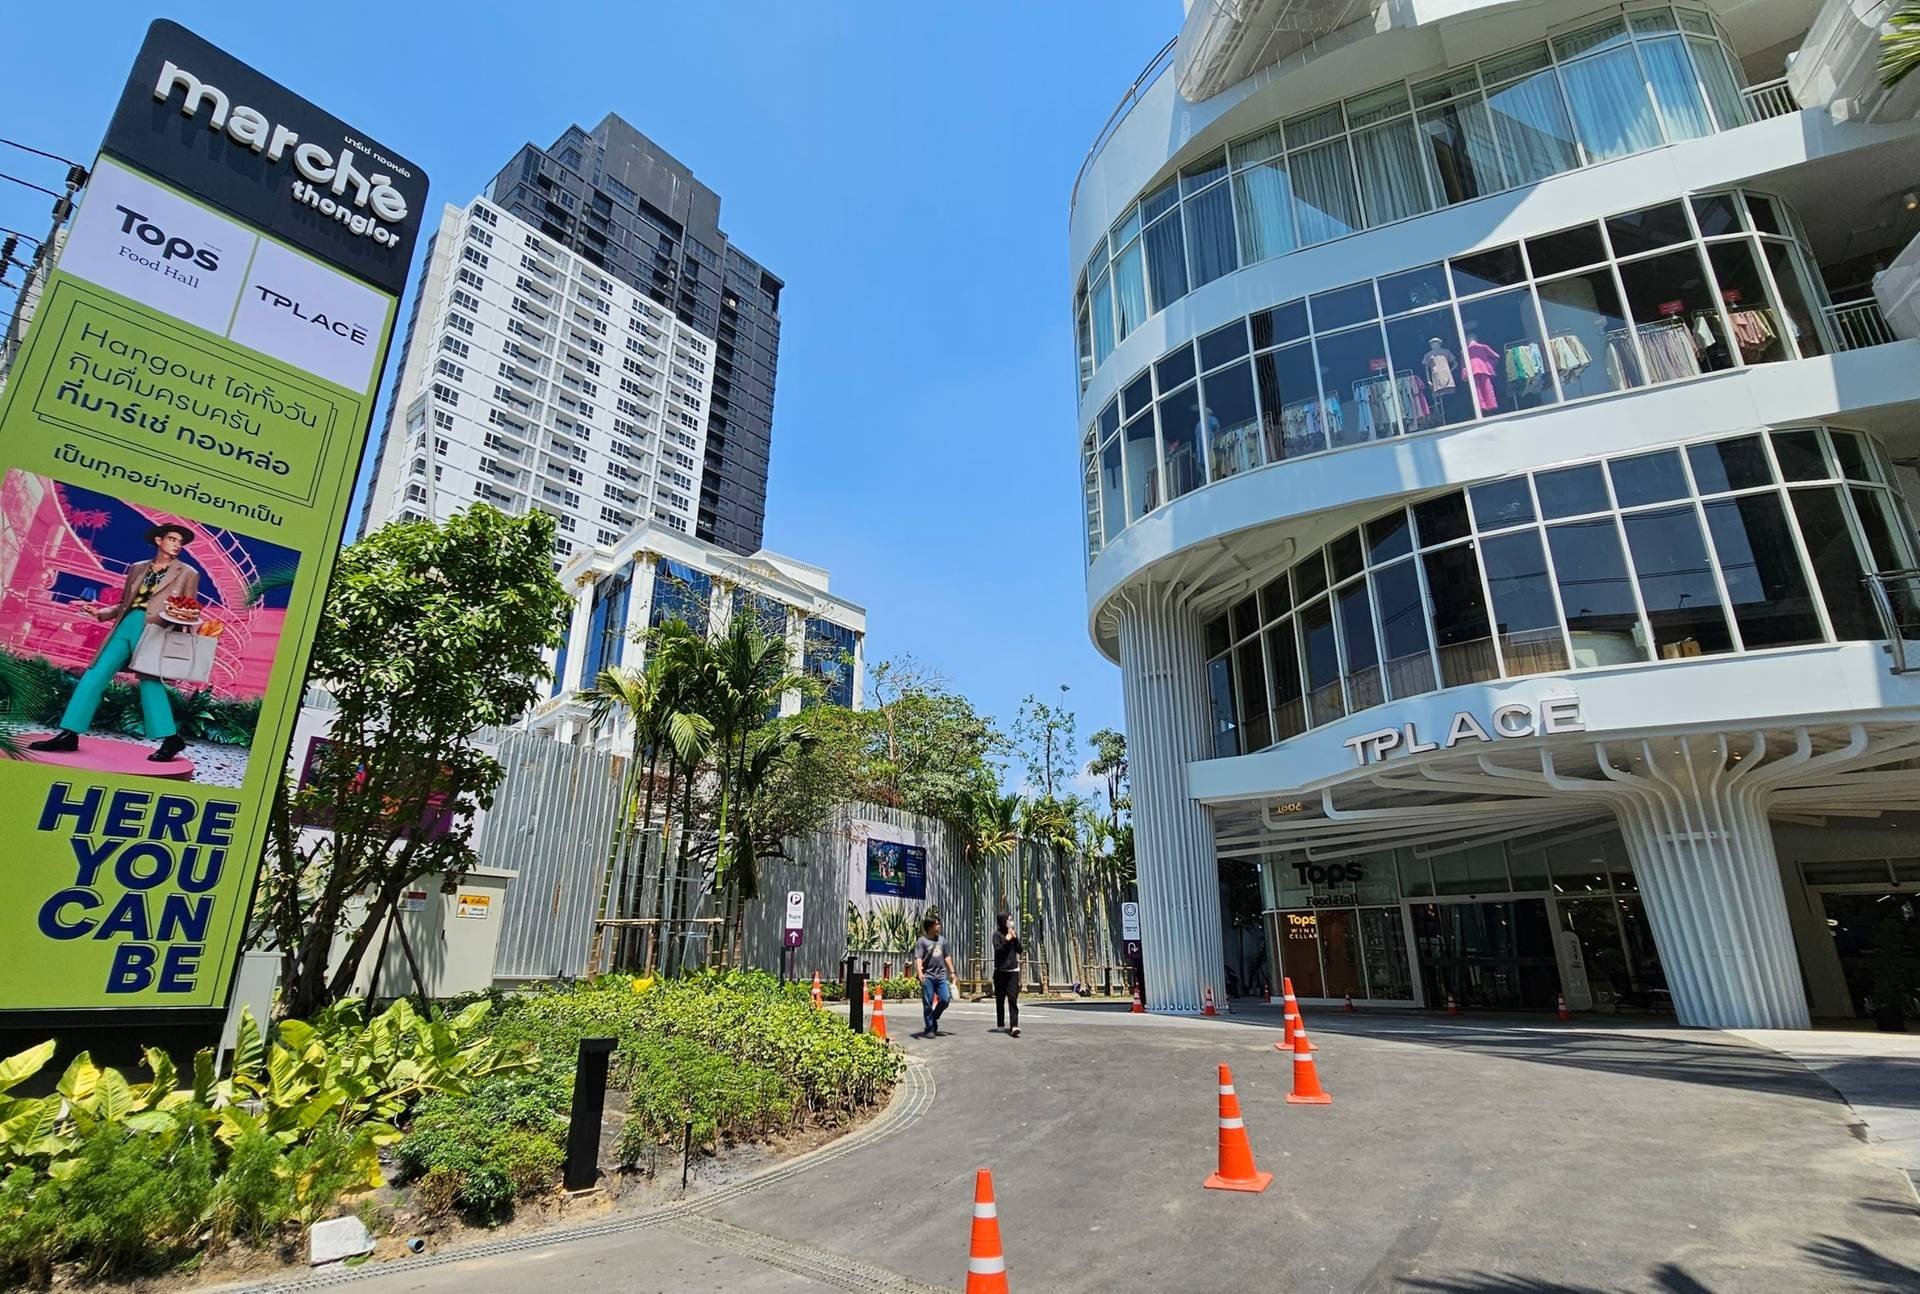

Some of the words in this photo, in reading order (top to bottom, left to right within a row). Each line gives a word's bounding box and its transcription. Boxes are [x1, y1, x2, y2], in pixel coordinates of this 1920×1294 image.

[115, 204, 220, 272] Tops
[291, 180, 400, 248] thonglor
[119, 245, 161, 272] Food
[163, 265, 200, 289] Hall
[254, 285, 367, 346] TPLACE
[69, 351, 261, 437] กินดื่มครบครัน
[81, 322, 216, 390] Hangout
[225, 376, 317, 428] ได้ทั้งวัน
[56, 378, 171, 434] ที่มาร์เช่
[176, 426, 290, 476] ทองหล่อ
[53, 443, 283, 527] เป็นทุกอย่างที่อยากเป็น
[1343, 697, 1585, 766] TPLACE
[38, 781, 241, 846] HERE
[70, 835, 228, 893] YOU
[1292, 861, 1363, 890] Tops
[38, 887, 216, 941] CAN
[1287, 914, 1316, 926] Tops
[105, 942, 205, 993] BE
